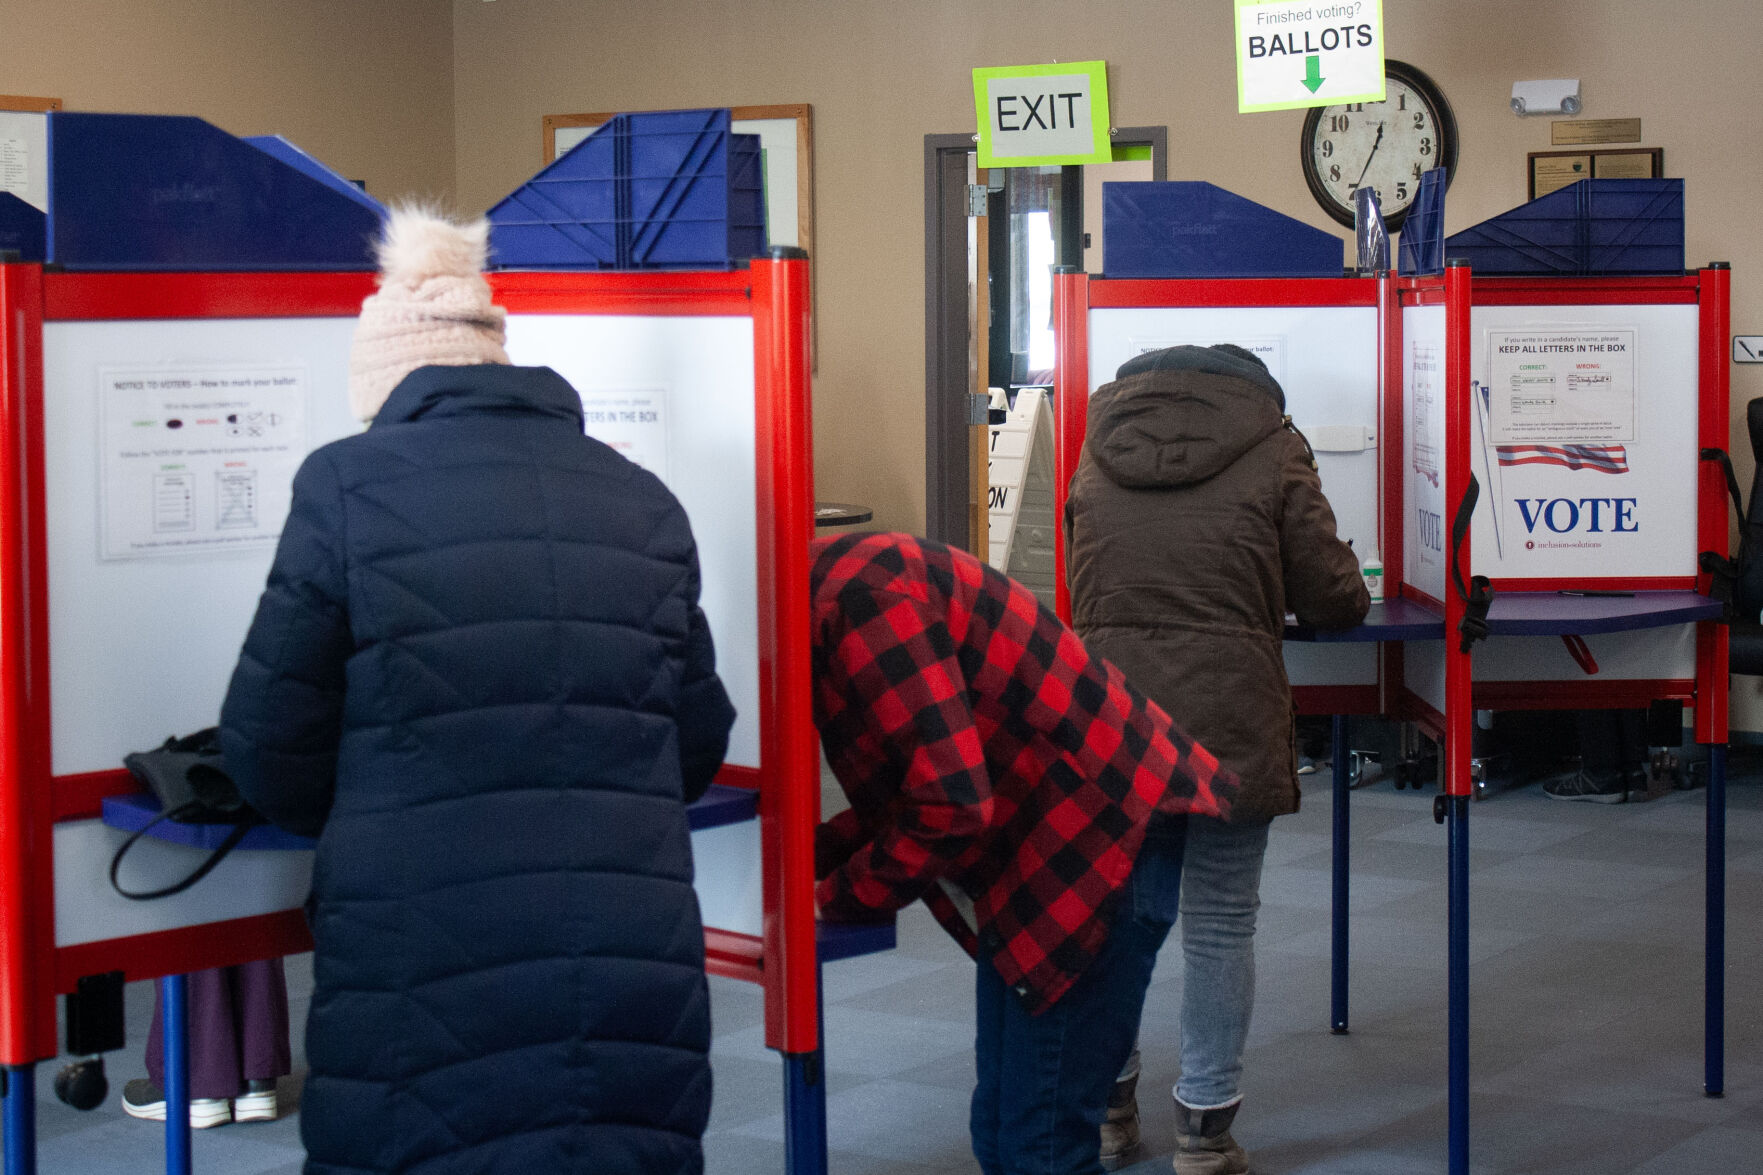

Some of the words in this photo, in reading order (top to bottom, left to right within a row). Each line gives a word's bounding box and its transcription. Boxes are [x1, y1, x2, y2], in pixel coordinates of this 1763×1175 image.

[1257, 8, 1312, 25] Finished
[1316, 1, 1362, 19] voting?
[1248, 24, 1373, 58] BALLOTS
[1398, 93, 1407, 110] 1
[996, 93, 1082, 131] EXIT
[1413, 112, 1425, 130] 2
[1329, 114, 1349, 132] 10
[1322, 140, 1333, 158] 9
[1419, 137, 1431, 156] 3
[1330, 164, 1341, 182] 8
[1412, 162, 1423, 181] 4
[1397, 182, 1407, 200] 5
[1499, 345, 1520, 353] KEEP
[1521, 345, 1537, 353] ALL
[1539, 344, 1575, 353] LETTERS
[1576, 344, 1586, 352] IN
[1588, 344, 1605, 352] THE
[1607, 344, 1626, 352] BOX
[619, 411, 636, 422] THE
[639, 411, 658, 422] BOX
[1514, 497, 1638, 534] VOTE
[1419, 508, 1441, 552] VOTE
